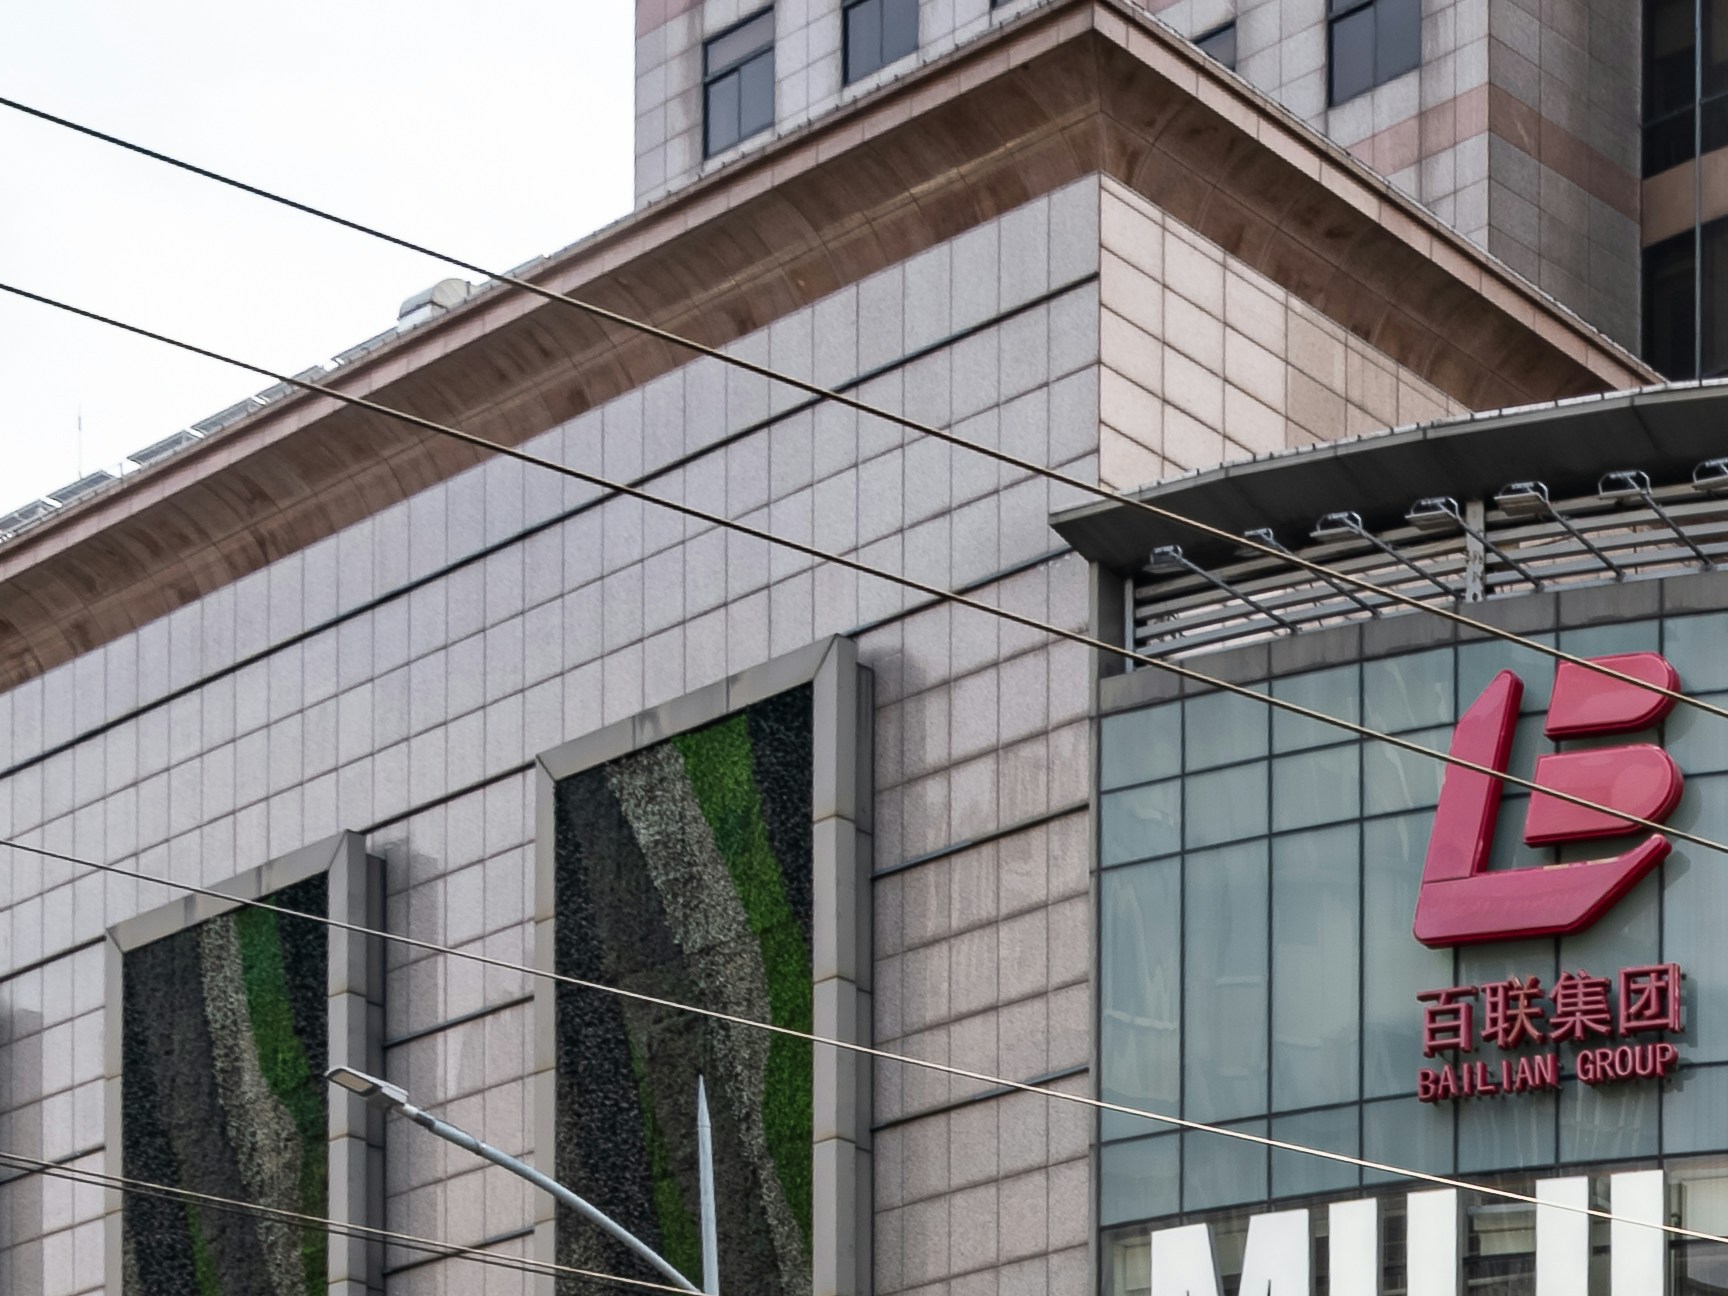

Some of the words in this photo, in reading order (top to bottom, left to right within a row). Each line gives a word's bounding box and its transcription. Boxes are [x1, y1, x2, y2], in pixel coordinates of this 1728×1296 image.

[1416, 962, 1685, 1058] 百联集团
[1417, 1053, 1559, 1103] BAILIAN
[1576, 1042, 1679, 1086] GROUP
